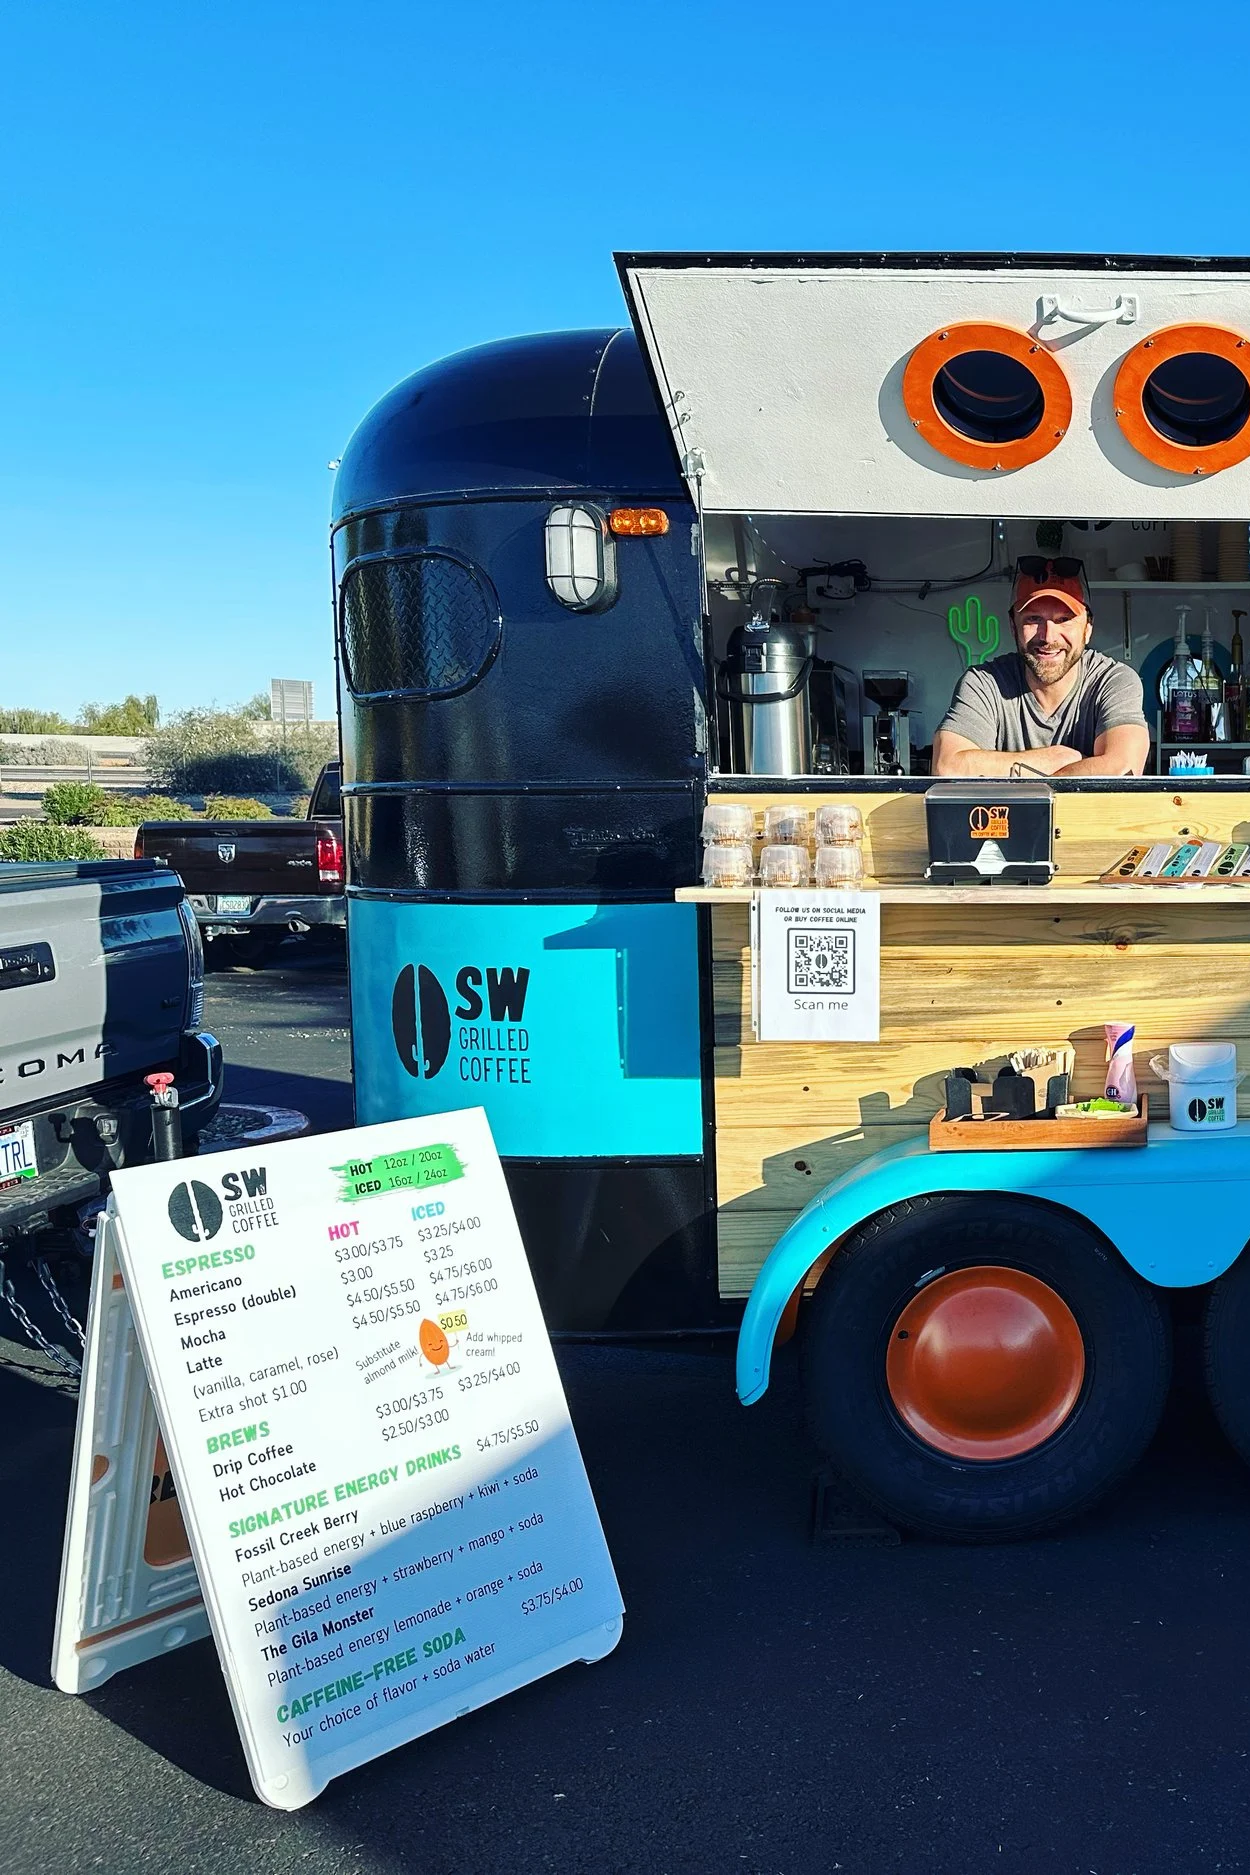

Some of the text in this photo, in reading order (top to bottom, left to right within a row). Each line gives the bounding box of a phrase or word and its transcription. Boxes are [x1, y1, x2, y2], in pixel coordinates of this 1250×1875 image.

[1173, 690, 1197, 698] LOTUS
[990, 808, 1007, 819] SW
[455, 965, 531, 1023] SW
[794, 999, 849, 1010] Scan me
[459, 1028, 530, 1052] GRILLED
[0, 1042, 119, 1083] OMA
[459, 1057, 531, 1084] COFFEE
[1208, 1098, 1224, 1109] SW
[224, 1166, 268, 1200] SW
[349, 1148, 443, 1178] HOT 12oz 20oz
[355, 1166, 448, 1196] ICED 16oz 24oz
[229, 1197, 275, 1218] GRILLED
[231, 1212, 280, 1235] COFFEE
[327, 1201, 446, 1242] HOT ICED
[161, 1244, 256, 1281] ESPRESSO
[169, 1216, 482, 1303] Americano $3.00/$3.75 $3.25/$4.00
[174, 1244, 455, 1328] Espresso (double) $3.00 $3.25
[180, 1257, 494, 1351] Mocha $4.50/$5.50 $4.75/$6.00
[186, 1278, 499, 1375] Latte $4.50/$5.50 $4.75/$6.00
[440, 1313, 468, 1331] $0.50
[466, 1332, 524, 1347] Add whipped
[354, 1338, 402, 1373] Substitute
[362, 1344, 420, 1386] almond milk!
[466, 1344, 496, 1359] cream!
[193, 1346, 340, 1401] (vanilla, caramel, rose)
[198, 1378, 308, 1424] Extra shot $1.00
[206, 1421, 270, 1454] BREWS
[212, 1361, 522, 1483] Drip Coffee $3.00/$3.75 $3.25/$4.00
[219, 1408, 450, 1502] Hot Chocolate $2.50/$3.00
[228, 1418, 540, 1539] SIGNATURE ENERGY DRINKS $4.75/$5.50
[235, 1508, 360, 1563] Fossil Creek Berry
[241, 1465, 540, 1588] Plant-based energy blue raspberry kiwi soda
[248, 1562, 352, 1612] Sedona Sunrise
[254, 1510, 544, 1638] Plant-based energy strawberry mango soda
[260, 1605, 376, 1662] The Gila Monster
[266, 1560, 544, 1688] Plant-based energy lemonade orange soda
[422, 1627, 467, 1658] SODA
[520, 1577, 585, 1616] $3.75/$4.00
[282, 1642, 497, 1749] Your choice of flavor soda water
